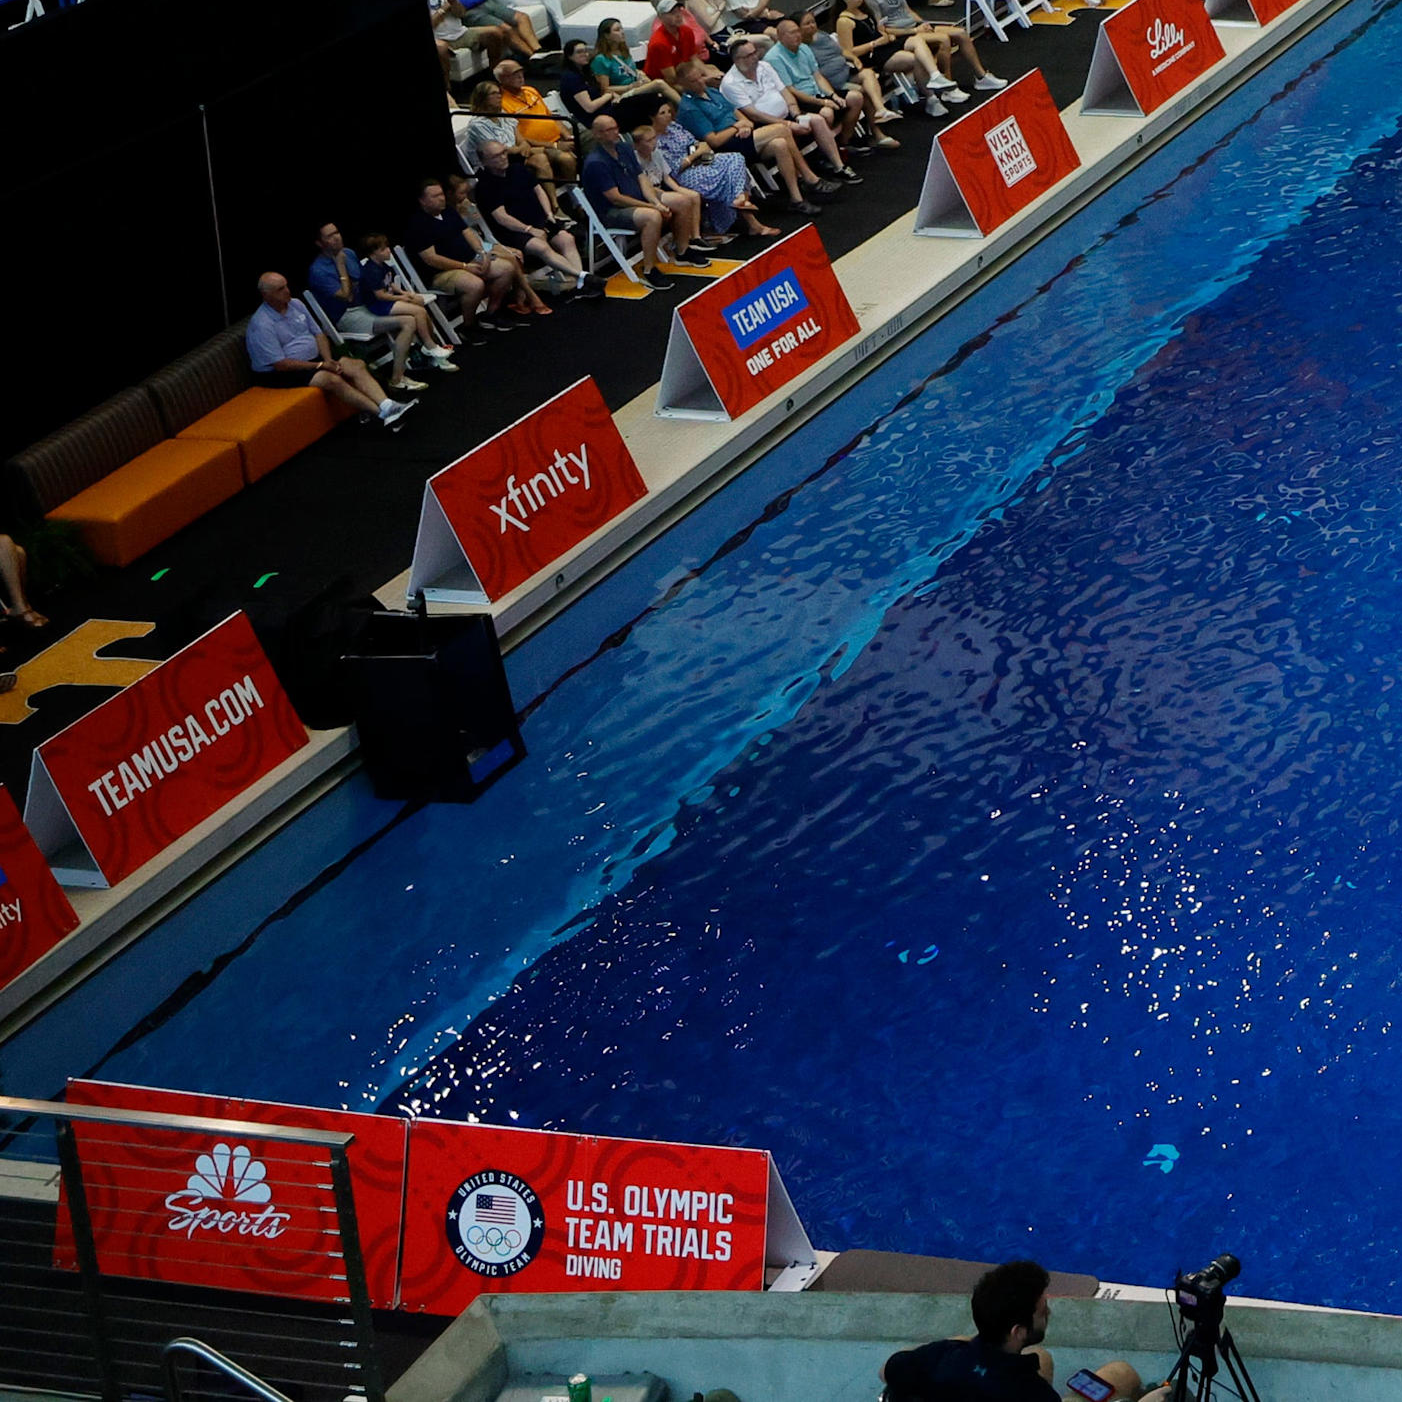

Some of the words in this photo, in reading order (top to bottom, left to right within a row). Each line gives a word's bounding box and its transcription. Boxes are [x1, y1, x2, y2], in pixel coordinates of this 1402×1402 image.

[1146, 17, 1184, 60] Lilly
[990, 121, 1020, 152] VISIT
[997, 139, 1027, 169] KNOX
[1004, 155, 1032, 181] SPORTS
[731, 296, 772, 337] TEAM
[766, 280, 799, 315] USA
[746, 347, 774, 376] ONE
[771, 331, 799, 360] FOR
[796, 317, 822, 345] ALL
[488, 443, 591, 535] xfinity
[88, 674, 265, 817] TEAMUSA.COM
[457, 1172, 495, 1198] UNITED
[499, 1173, 536, 1204] STATES
[566, 1179, 615, 1215] U.S.
[623, 1184, 734, 1225] OLYMPIC
[164, 1189, 292, 1241] Sports
[454, 1244, 498, 1277] OLYMPIC
[503, 1251, 532, 1275] TEAM
[564, 1216, 635, 1254] TEAM
[641, 1223, 733, 1263] TRIALS
[564, 1254, 622, 1281] DIVING
